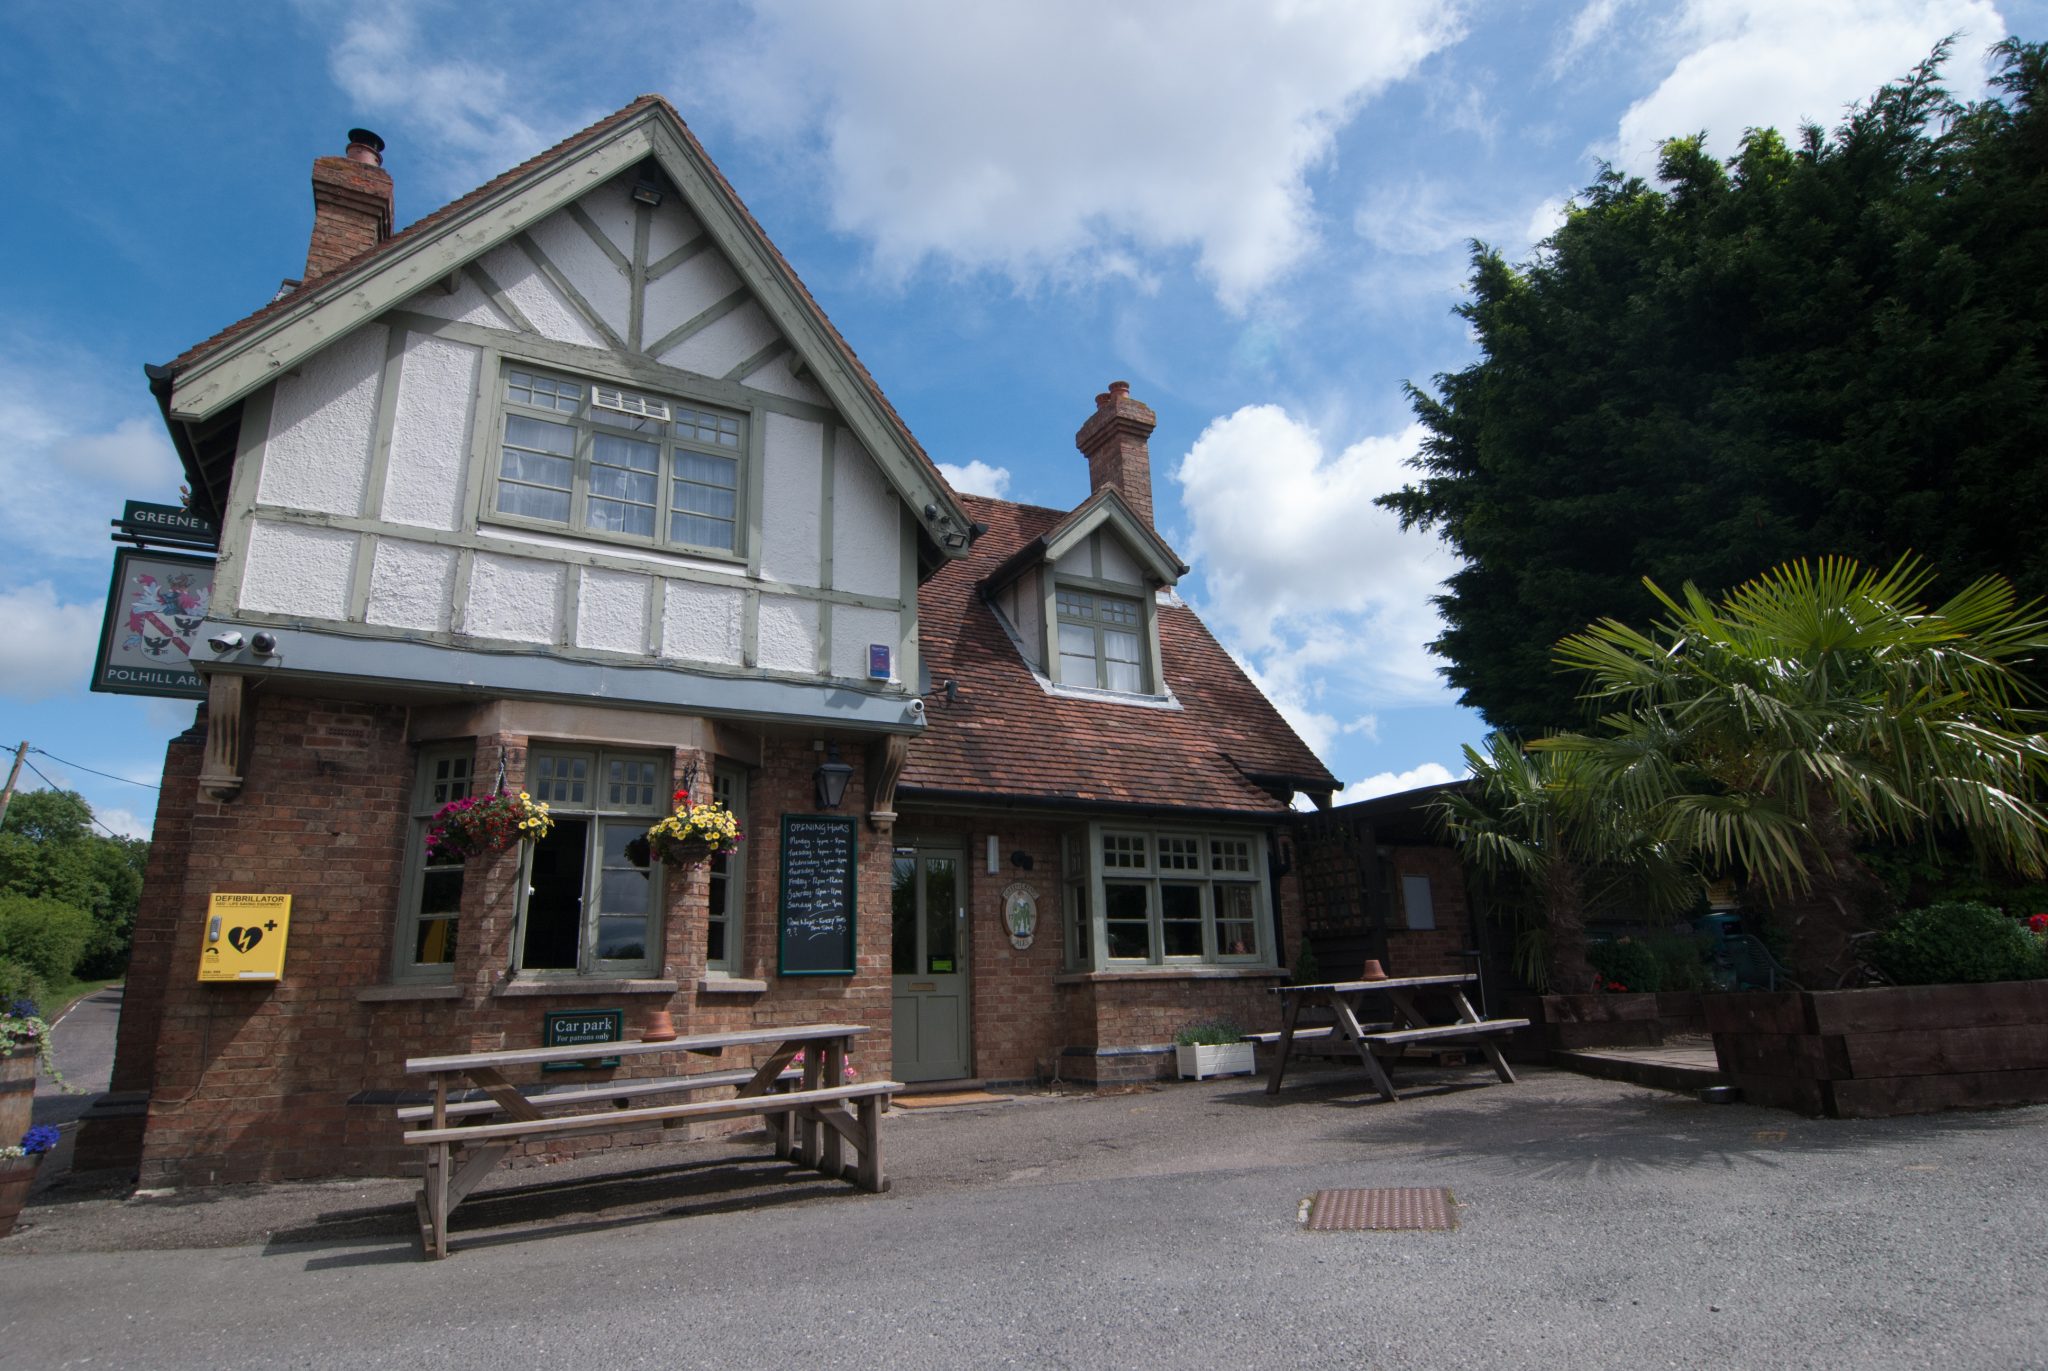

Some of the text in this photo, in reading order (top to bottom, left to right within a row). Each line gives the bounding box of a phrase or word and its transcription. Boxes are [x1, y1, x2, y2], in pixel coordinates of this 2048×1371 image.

[134, 510, 199, 528] GREENE
[107, 669, 172, 684] POLHILL
[789, 836, 811, 848] Monday
[788, 848, 812, 858] Tuesday
[215, 895, 285, 903] DEFIBRILLATOR
[787, 901, 812, 912] Sunday
[555, 1017, 612, 1034] Car park
[569, 1034, 594, 1043] patrons
[595, 1032, 610, 1040] only
